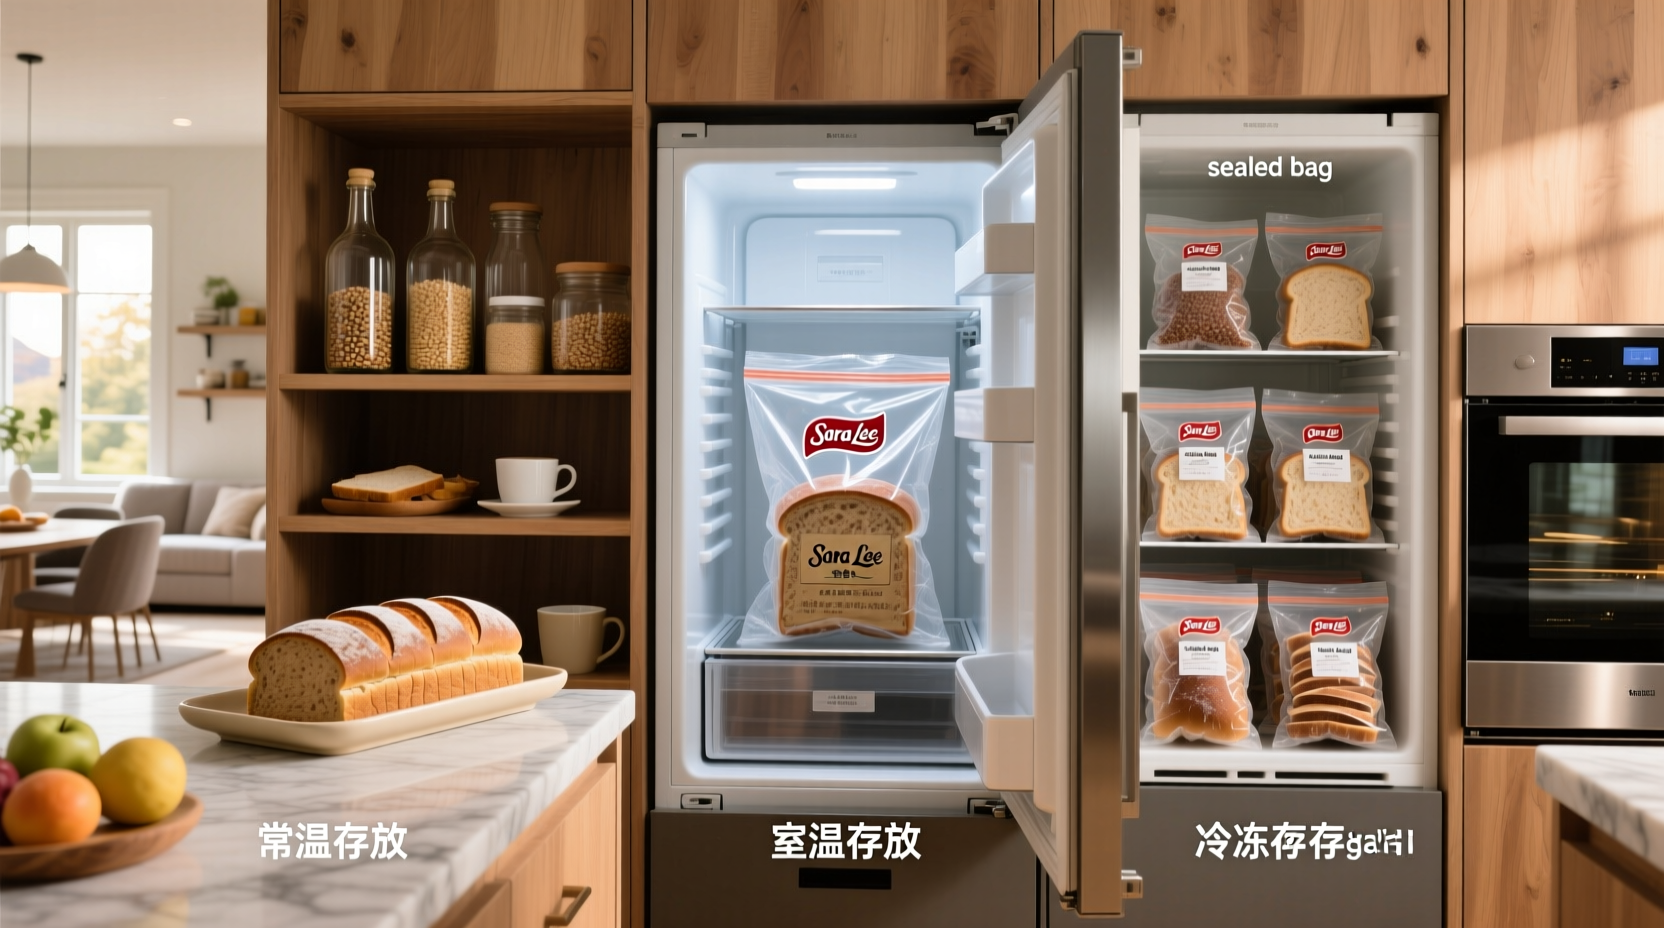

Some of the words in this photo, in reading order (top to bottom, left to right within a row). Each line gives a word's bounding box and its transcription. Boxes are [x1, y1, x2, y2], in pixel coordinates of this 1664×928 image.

[810, 422, 852, 446] Sara
[851, 422, 879, 446] Lee
[808, 543, 850, 568] Sara
[851, 544, 884, 568] Lee
